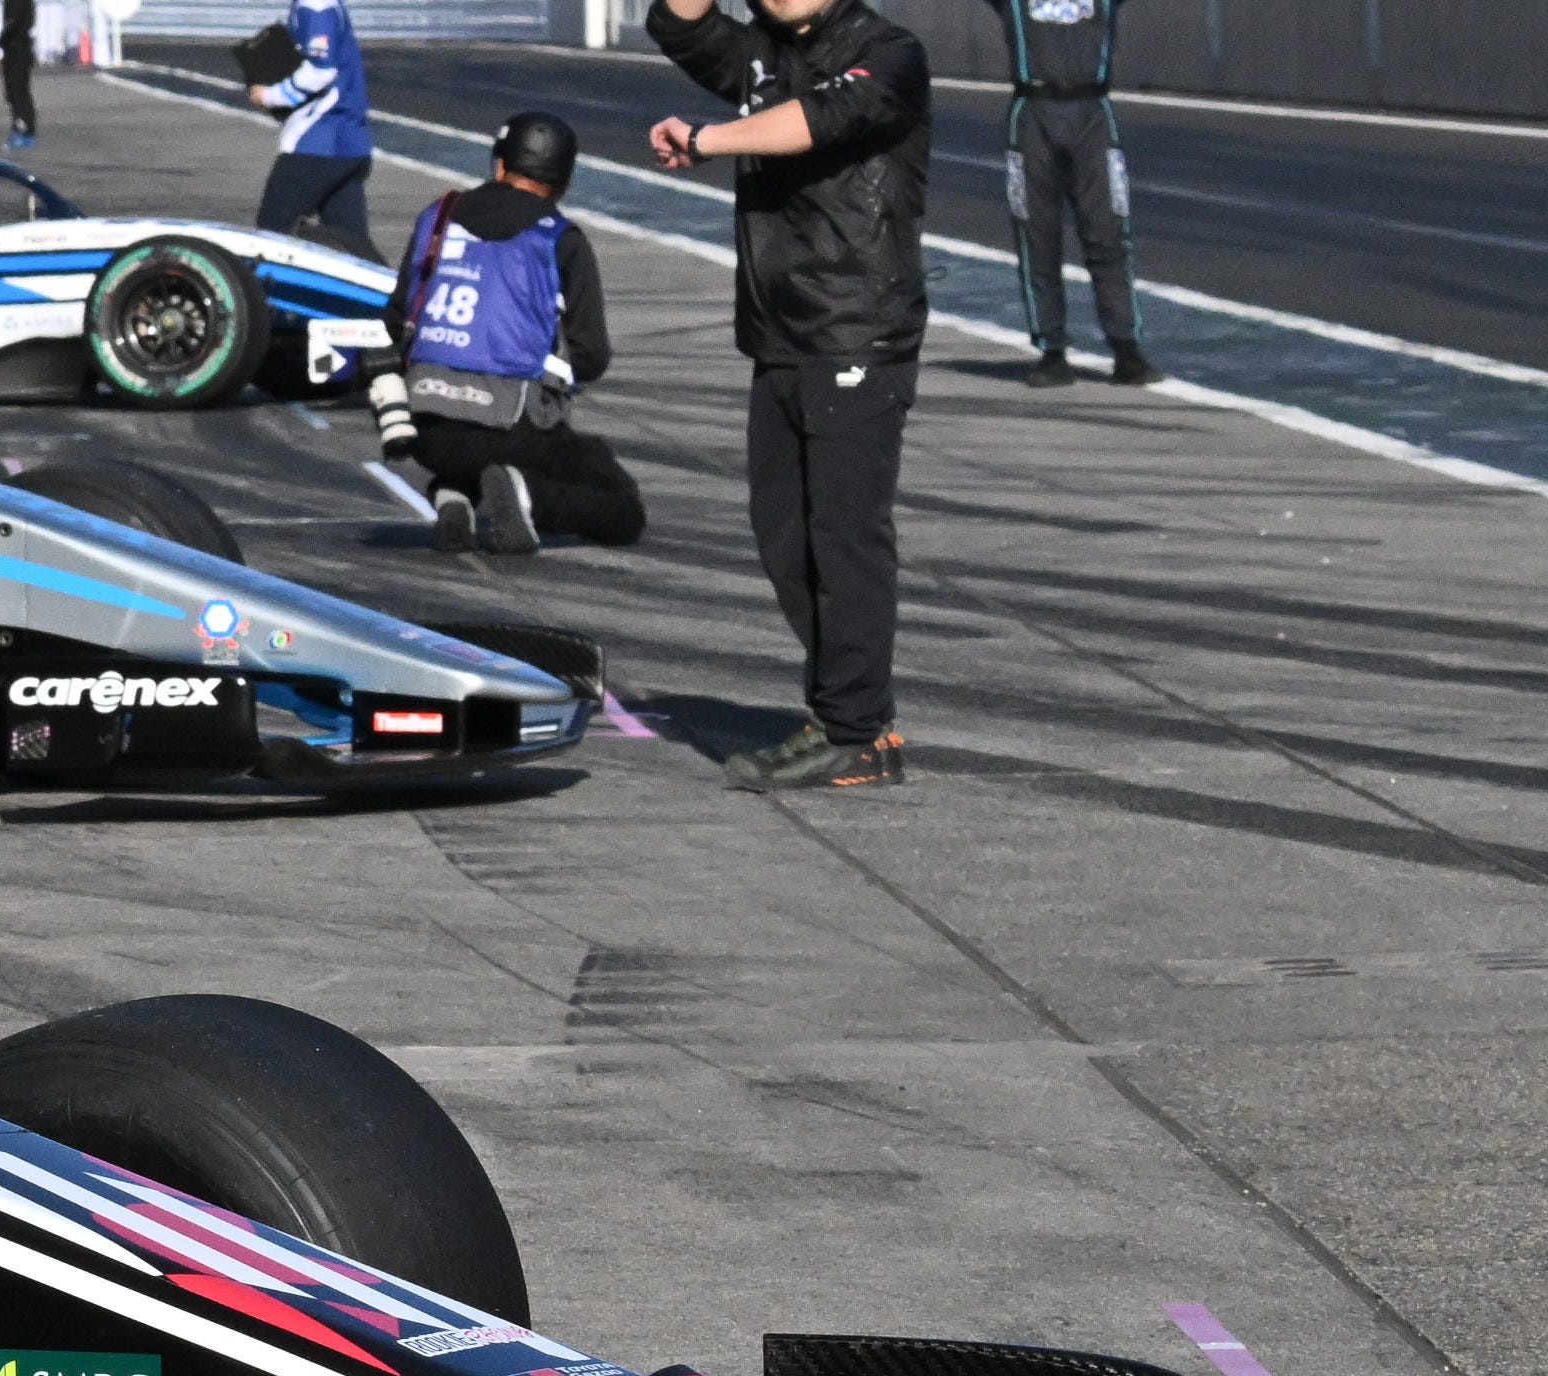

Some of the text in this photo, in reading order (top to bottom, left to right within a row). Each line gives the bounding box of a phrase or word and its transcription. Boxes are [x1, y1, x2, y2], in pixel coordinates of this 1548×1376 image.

[424, 282, 480, 326] 48
[402, 1330, 469, 1356] ROOKIE
[555, 1362, 616, 1375] TOYOTA
